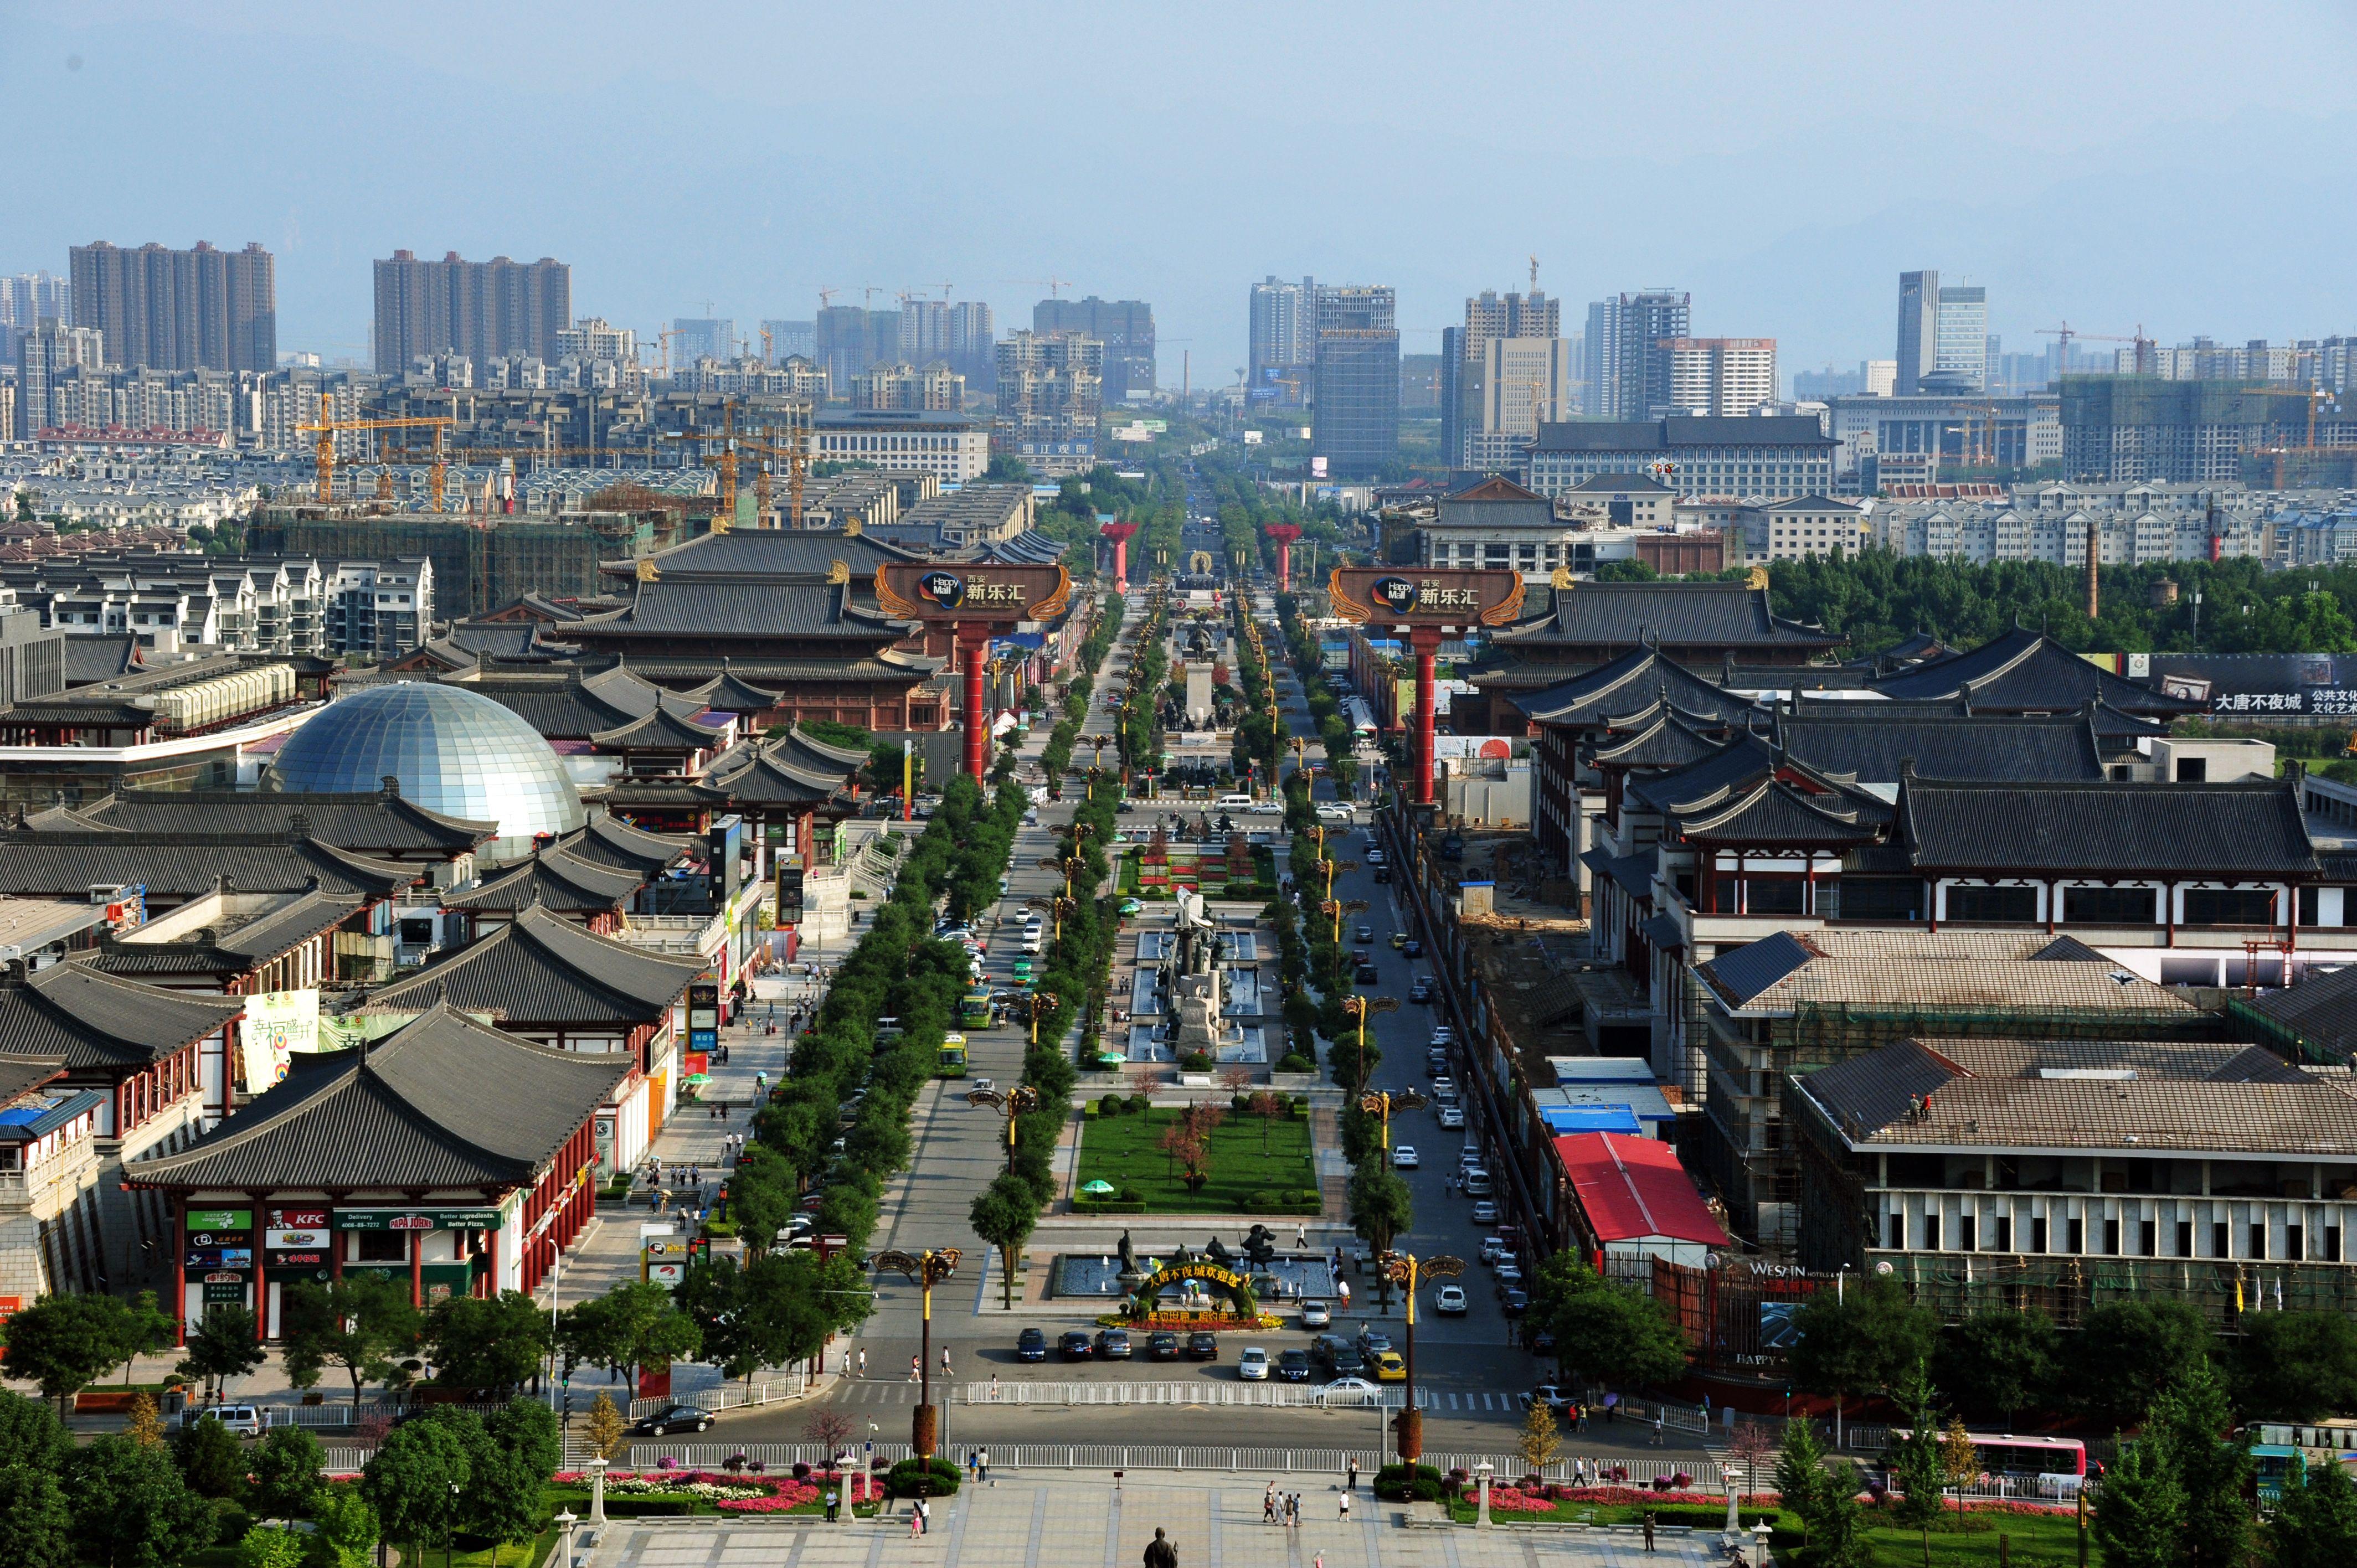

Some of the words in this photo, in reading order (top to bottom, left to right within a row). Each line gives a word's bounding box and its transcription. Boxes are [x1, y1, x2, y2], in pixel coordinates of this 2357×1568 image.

[933, 577, 959, 588] Happy
[967, 575, 986, 583] 西安
[1421, 579, 1440, 587] 西安
[933, 586, 951, 595] Mall
[966, 584, 1026, 600] 新乐汇
[1388, 582, 1413, 592] Happy
[1388, 590, 1406, 599] Mall
[1419, 589, 1479, 605] 新乐汇
[2216, 693, 2302, 710] 大唐不夜城
[2312, 690, 2357, 702] 公共文化
[2311, 702, 2357, 714] 文化艺术
[295, 1214, 325, 1224] KFC
[390, 1219, 408, 1228] PAPA
[409, 1217, 432, 1228] JOHNS
[1749, 1262, 1805, 1277] WESTIN
[1149, 1265, 1238, 1289] 大唐不夜城欢迎您
[1198, 1311, 1239, 1321] 相约曲江
[1736, 1353, 1776, 1366] HAPPY
